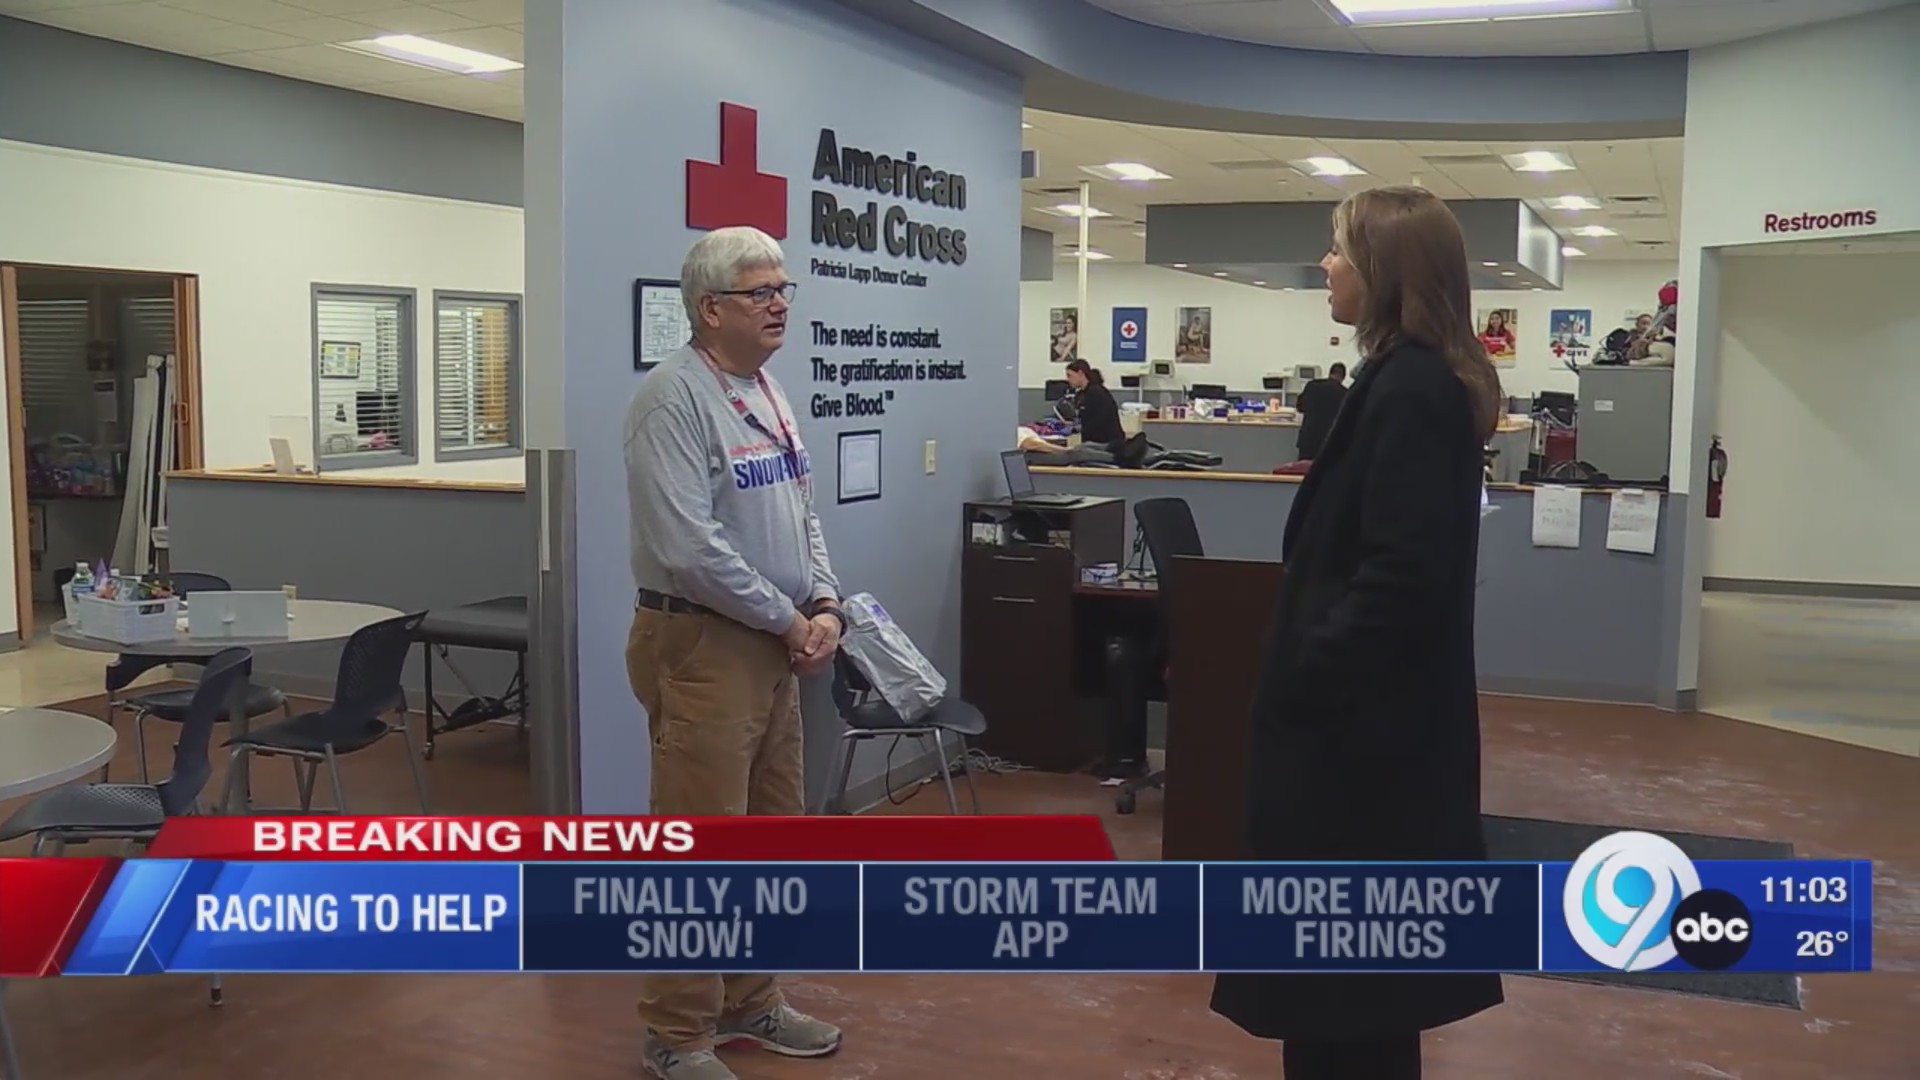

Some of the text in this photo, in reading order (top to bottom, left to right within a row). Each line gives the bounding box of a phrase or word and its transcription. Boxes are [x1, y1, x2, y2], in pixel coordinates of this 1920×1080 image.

[812, 127, 967, 211] American
[811, 189, 967, 266] Red Cross
[1763, 209, 1877, 233] Restrooms
[811, 258, 927, 287] Patricia Lapp Donor Center
[811, 321, 942, 349] The need is constant.
[811, 357, 967, 387] The gratification is instant.
[811, 393, 842, 418] Give
